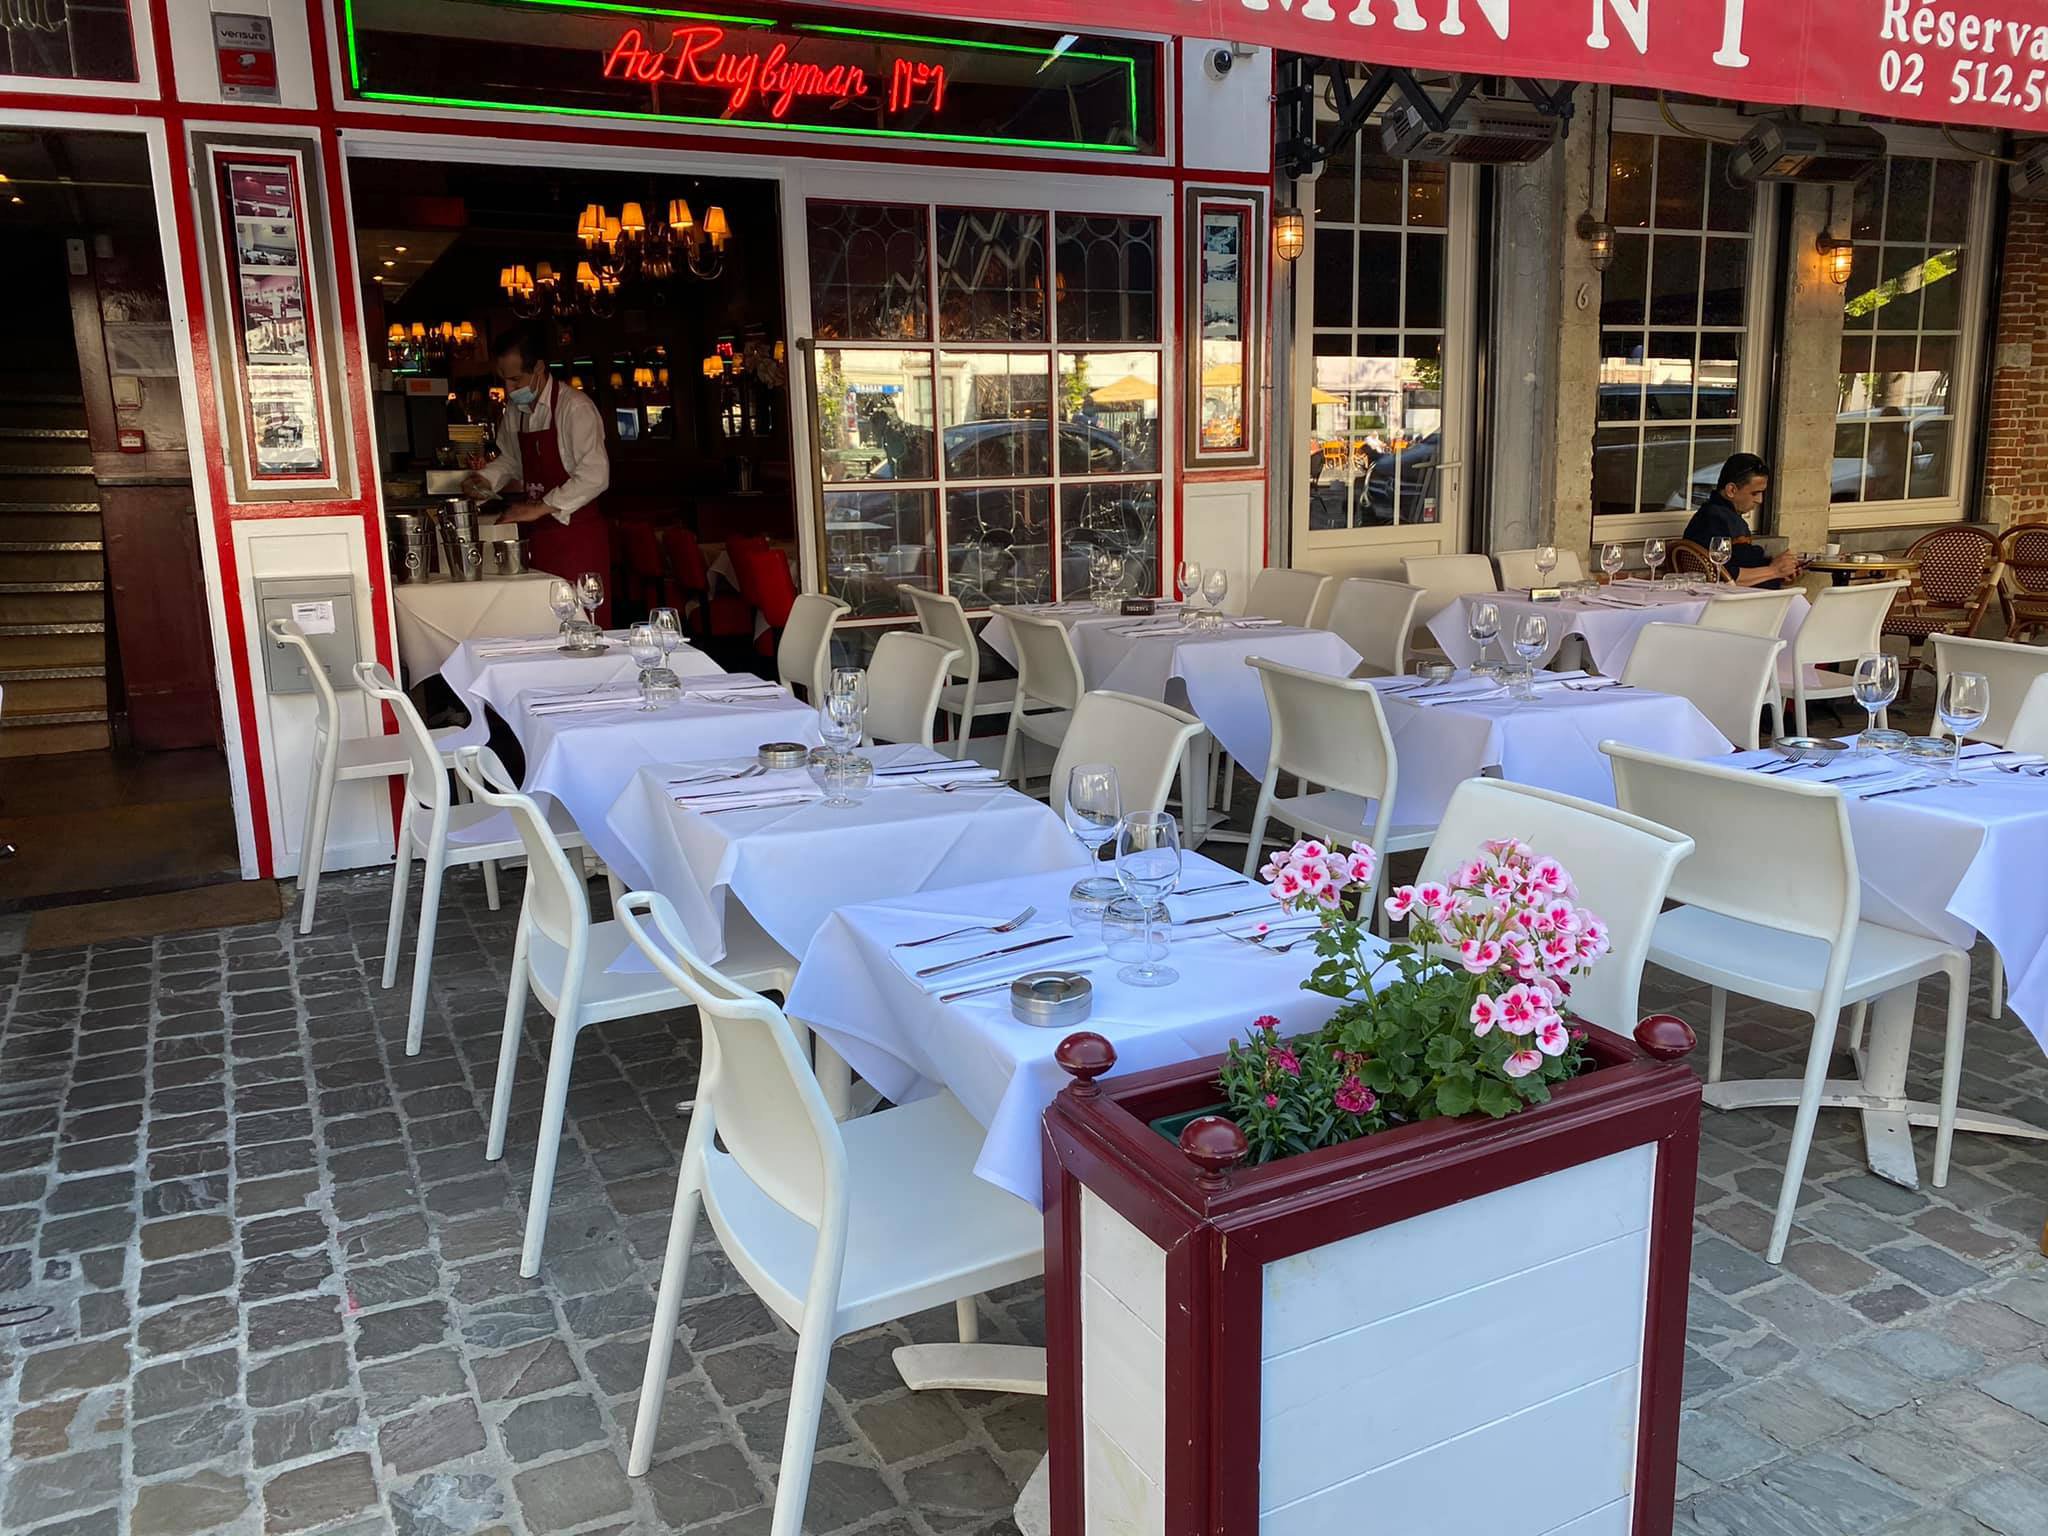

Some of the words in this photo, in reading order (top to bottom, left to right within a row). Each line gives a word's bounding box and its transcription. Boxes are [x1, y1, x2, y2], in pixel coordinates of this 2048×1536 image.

[220, 30, 266, 41] verisure
[604, 29, 666, 81] Au
[671, 26, 868, 118] Rugbyman
[1880, 50, 1925, 96] 02
[1948, 59, 2048, 112] 512.5
[1576, 283, 1588, 311] 6
